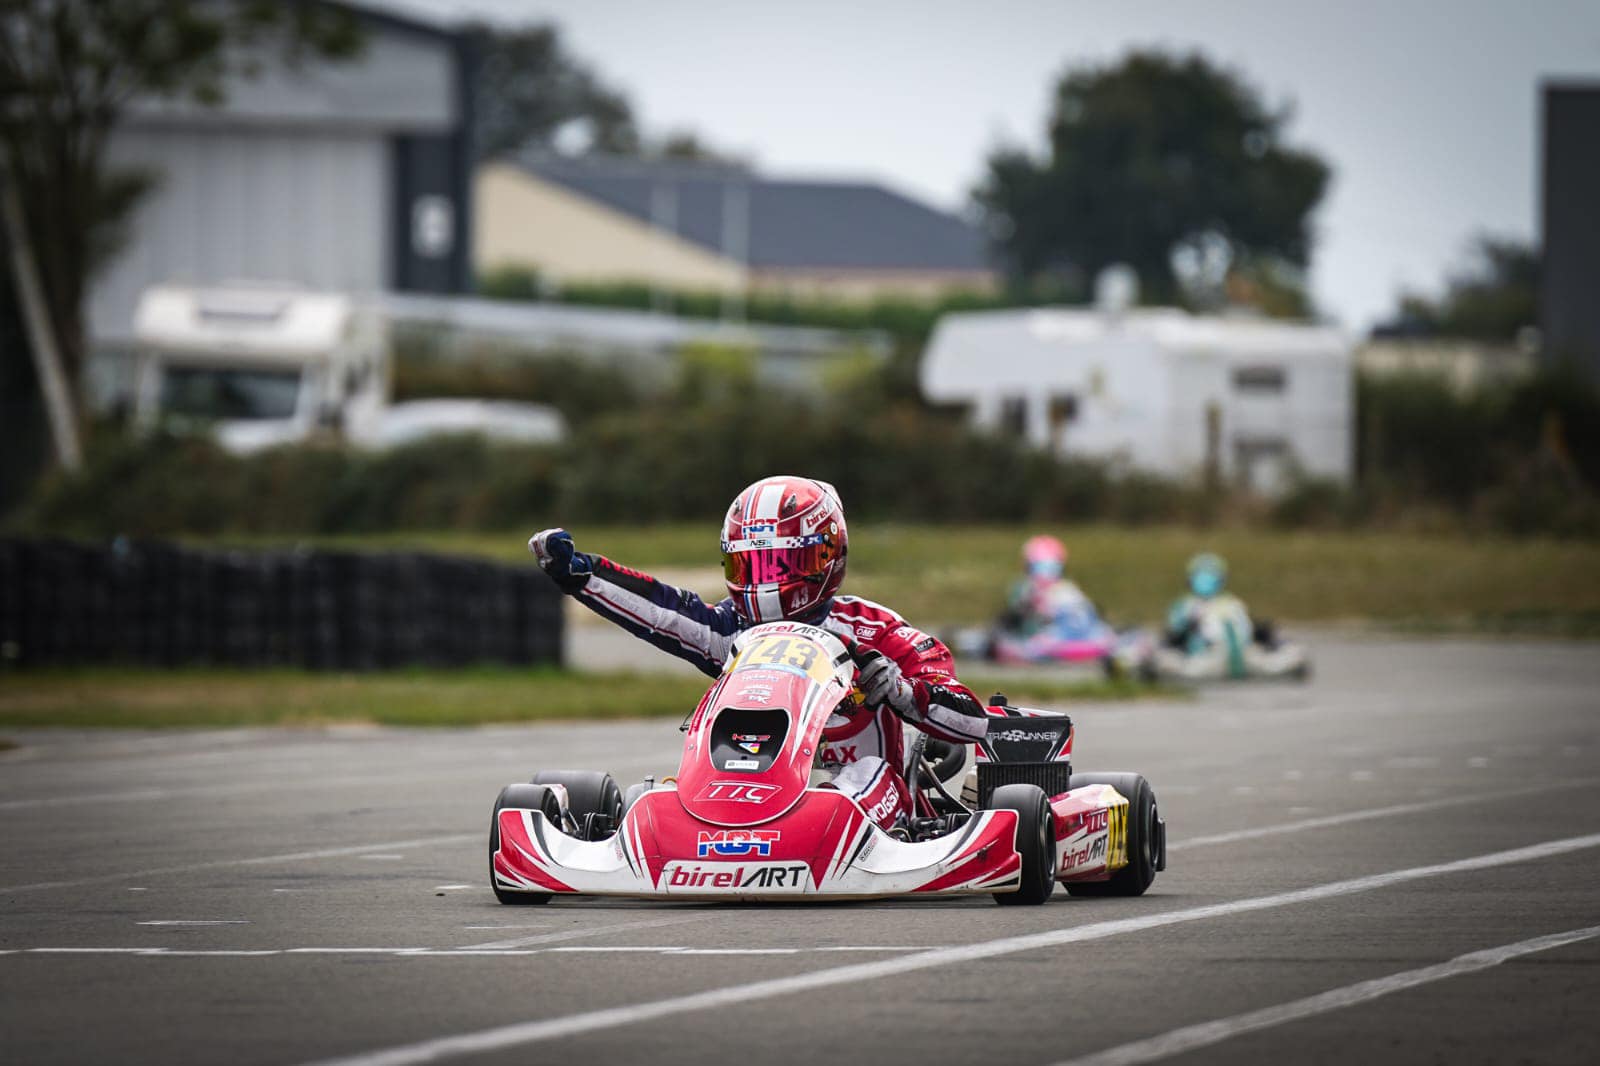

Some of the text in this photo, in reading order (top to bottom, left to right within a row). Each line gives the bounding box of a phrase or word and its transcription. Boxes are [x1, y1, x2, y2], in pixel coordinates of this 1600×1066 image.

[750, 624, 830, 639] birelART
[739, 639, 818, 671] 143
[707, 782, 776, 800] TTC
[1060, 834, 1108, 872] birelART
[668, 865, 807, 888] birelART
